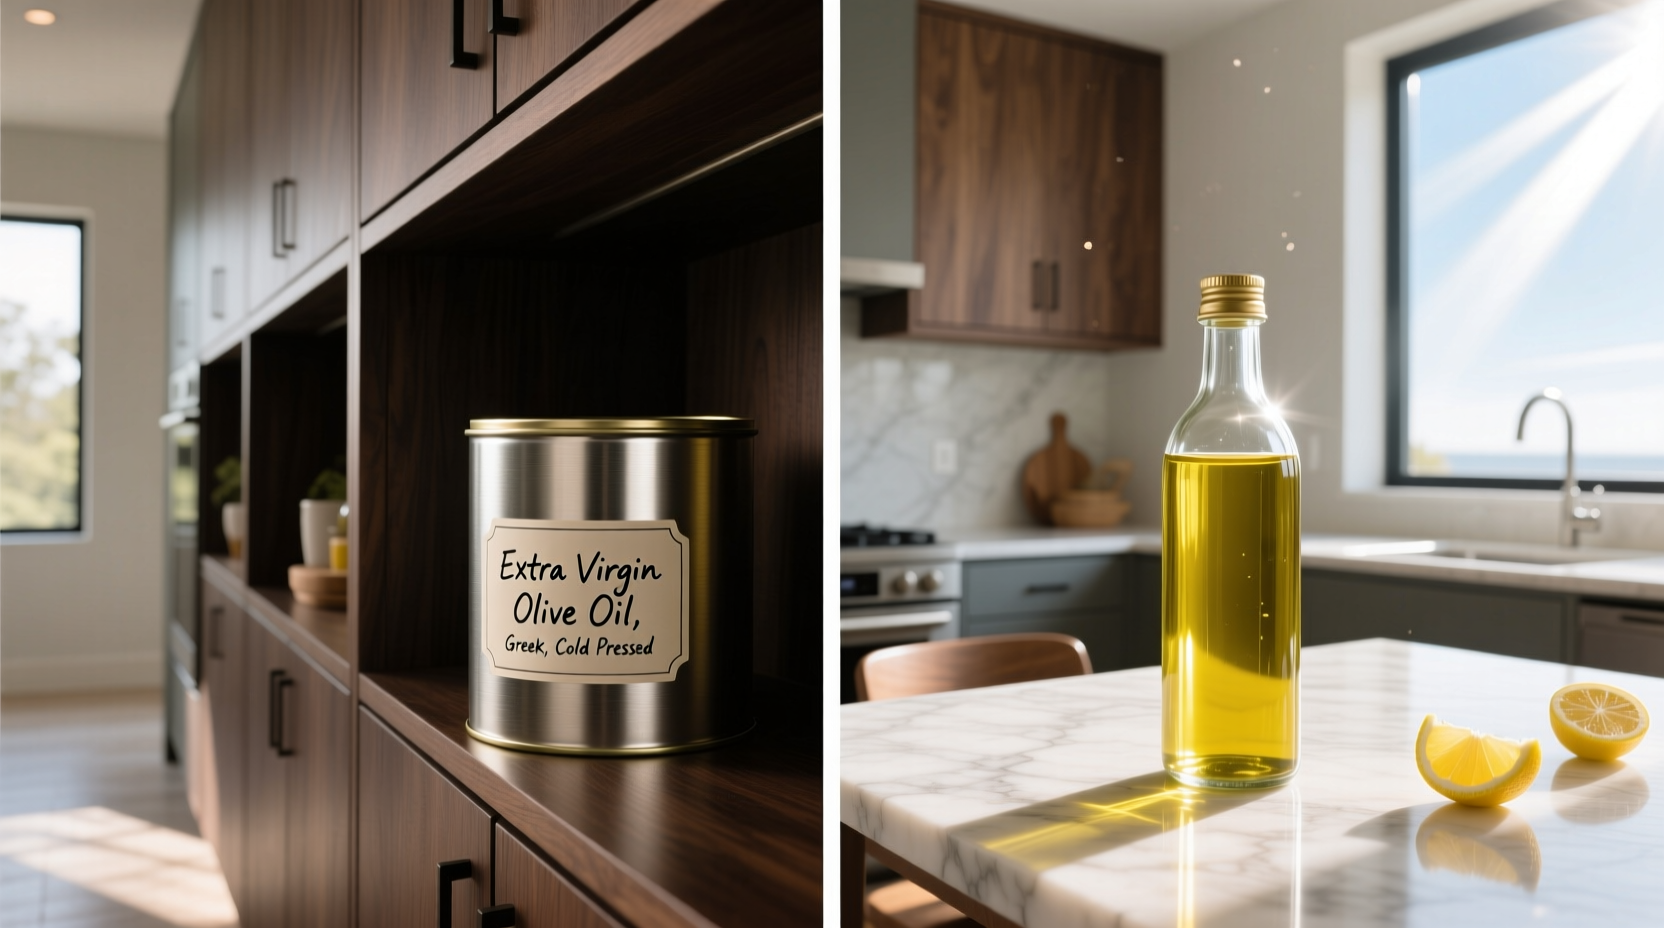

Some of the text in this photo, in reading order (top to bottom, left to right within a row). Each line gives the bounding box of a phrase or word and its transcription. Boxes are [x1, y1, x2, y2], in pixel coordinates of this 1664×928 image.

[499, 549, 662, 597] Extra Virgin
[513, 592, 640, 631] Olive Oil,
[505, 633, 655, 657] Greek, Cold Pressed
